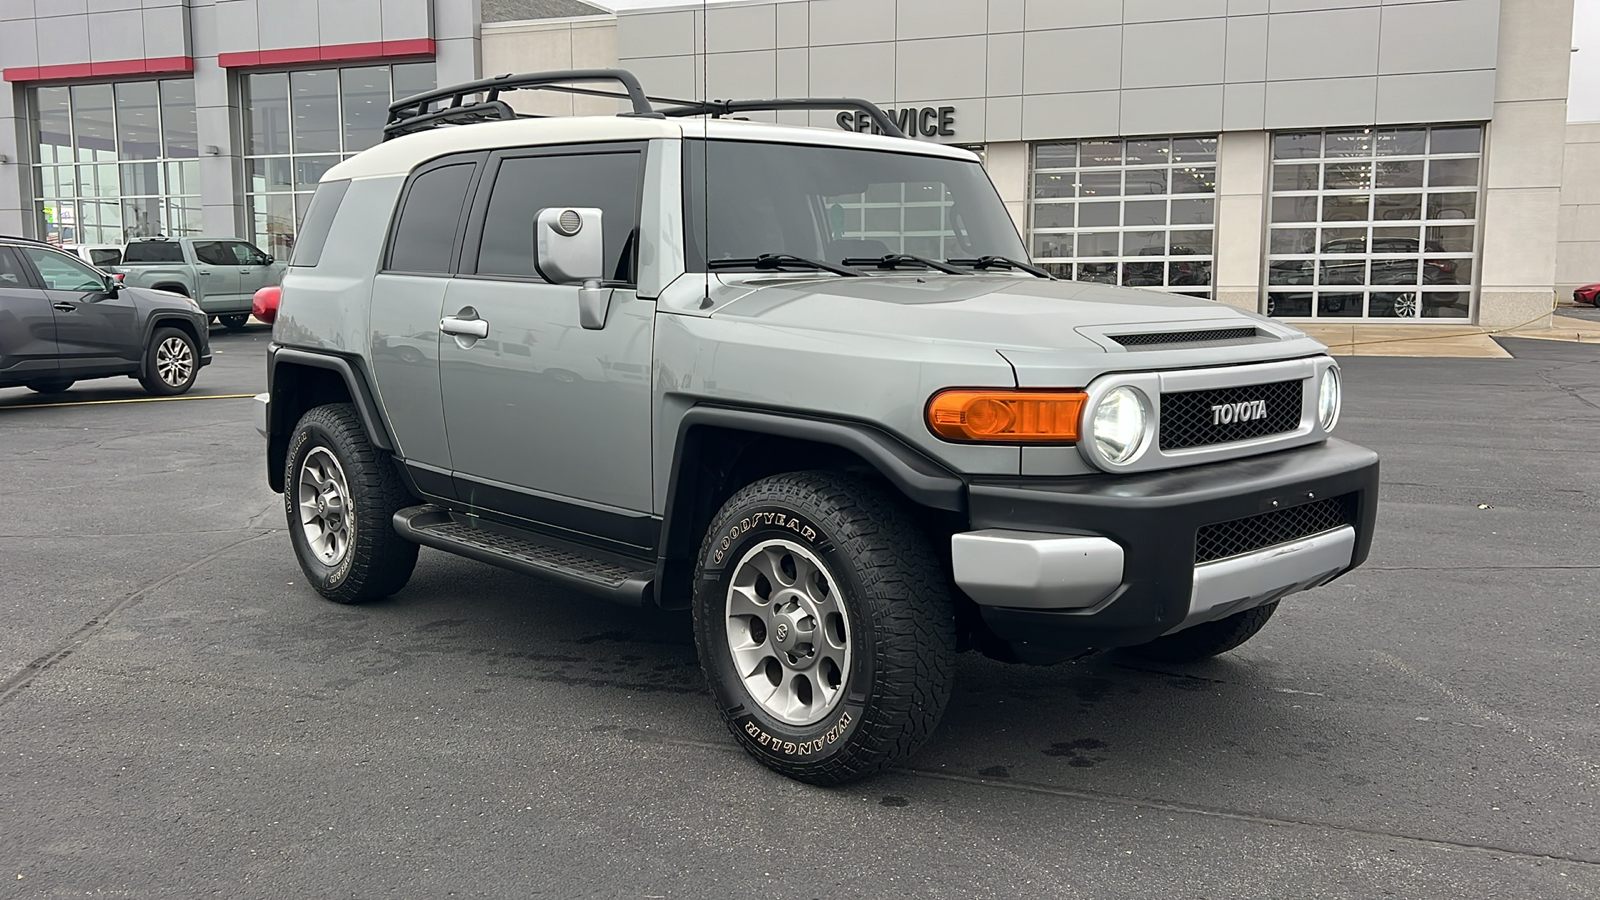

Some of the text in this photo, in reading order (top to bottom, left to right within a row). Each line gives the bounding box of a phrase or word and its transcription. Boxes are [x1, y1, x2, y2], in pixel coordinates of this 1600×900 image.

[1211, 400, 1267, 426] TOYOTA
[713, 512, 817, 564] GOODYEAR
[744, 711, 852, 755] WRANGLER
